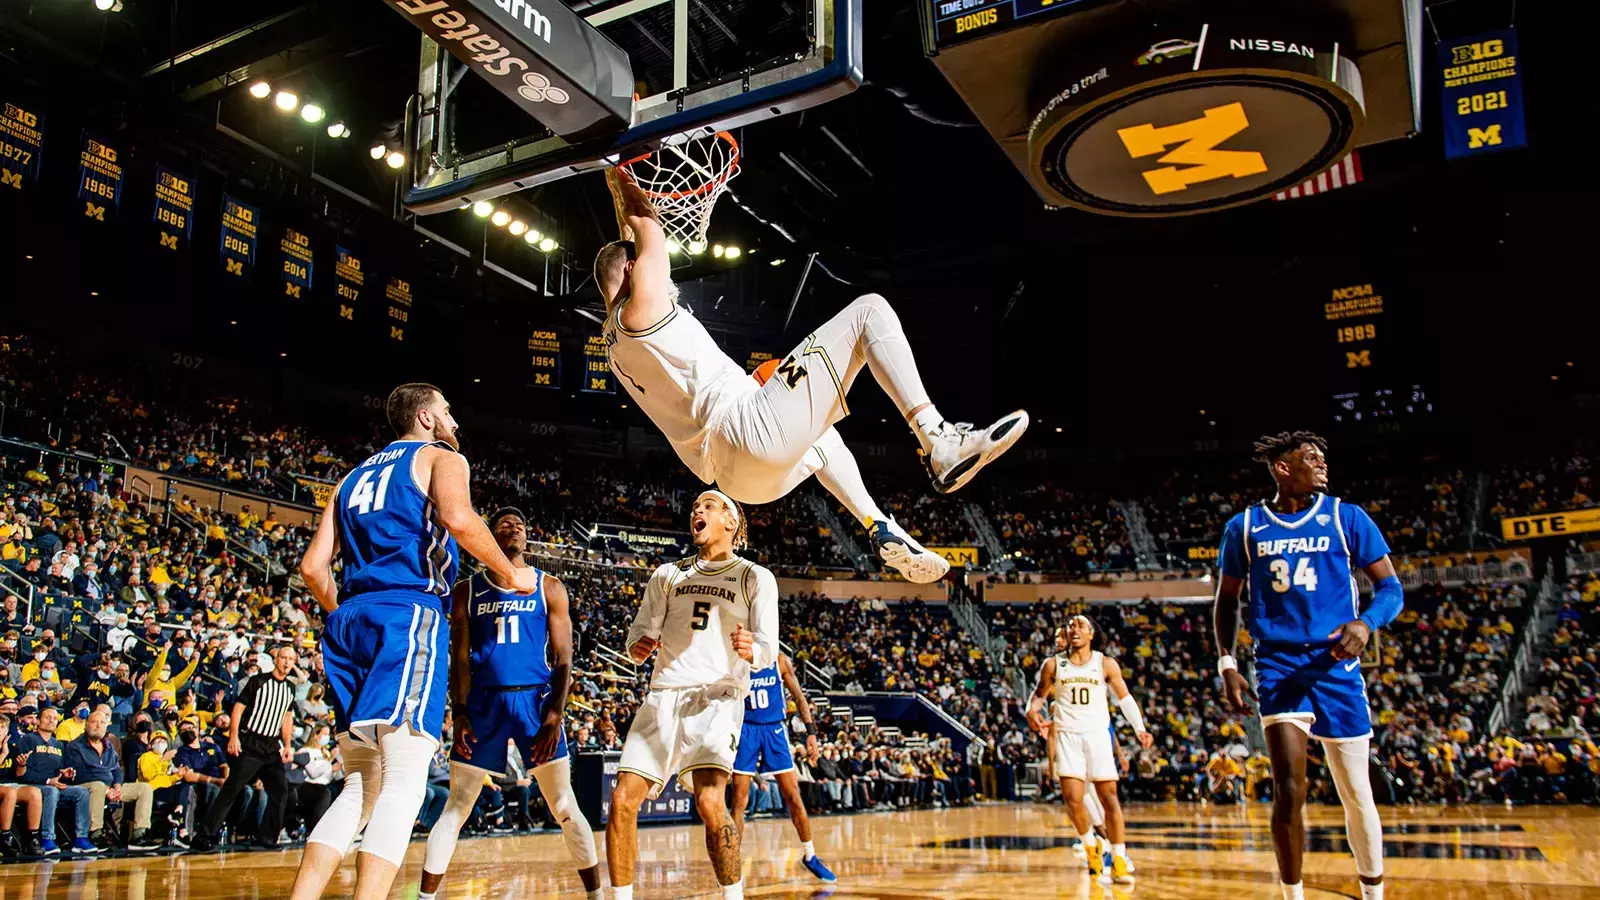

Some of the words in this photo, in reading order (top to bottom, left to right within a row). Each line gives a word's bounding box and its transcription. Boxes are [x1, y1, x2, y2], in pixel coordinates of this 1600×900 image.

[940, 2, 962, 16] TIME
[955, 8, 998, 34] BONUS
[431, 9, 528, 76] State
[1230, 38, 1315, 59] NISSAN
[1443, 56, 1516, 79] CHAMPIONS
[1457, 90, 1508, 116] 2021
[1467, 124, 1502, 149] M
[0, 141, 32, 165] 1977
[1116, 101, 1268, 196] M
[81, 151, 122, 175] CHAMPIONS
[1, 167, 23, 190] M
[84, 177, 115, 200] 1985
[85, 201, 105, 222] M
[157, 207, 185, 229] 1986
[160, 231, 178, 251] M
[225, 235, 249, 256] 2012
[226, 257, 243, 277] M
[284, 260, 307, 280] 2014
[285, 282, 301, 299] M
[338, 283, 359, 301] 2017
[1332, 283, 1373, 301] NCAA
[340, 303, 354, 321] M
[388, 306, 408, 322] 2018
[390, 326, 403, 341] M
[532, 330, 557, 341] NCAA
[588, 336, 607, 345] NCA
[1337, 323, 1376, 343] 1989
[532, 355, 556, 368] 1964
[1346, 349, 1371, 369] M
[535, 373, 550, 385] M
[777, 354, 808, 391] M
[591, 378, 607, 390] M
[347, 463, 396, 515] 41
[1513, 515, 1566, 536] DTE
[1257, 536, 1331, 557] BUFFALO
[1269, 557, 1318, 593] 34
[674, 584, 737, 603] MICHIGAN
[477, 599, 537, 616] BUFFALO
[691, 601, 711, 631] 5
[494, 615, 520, 644] 11
[750, 689, 769, 710] 10
[1071, 687, 1090, 705] 10
